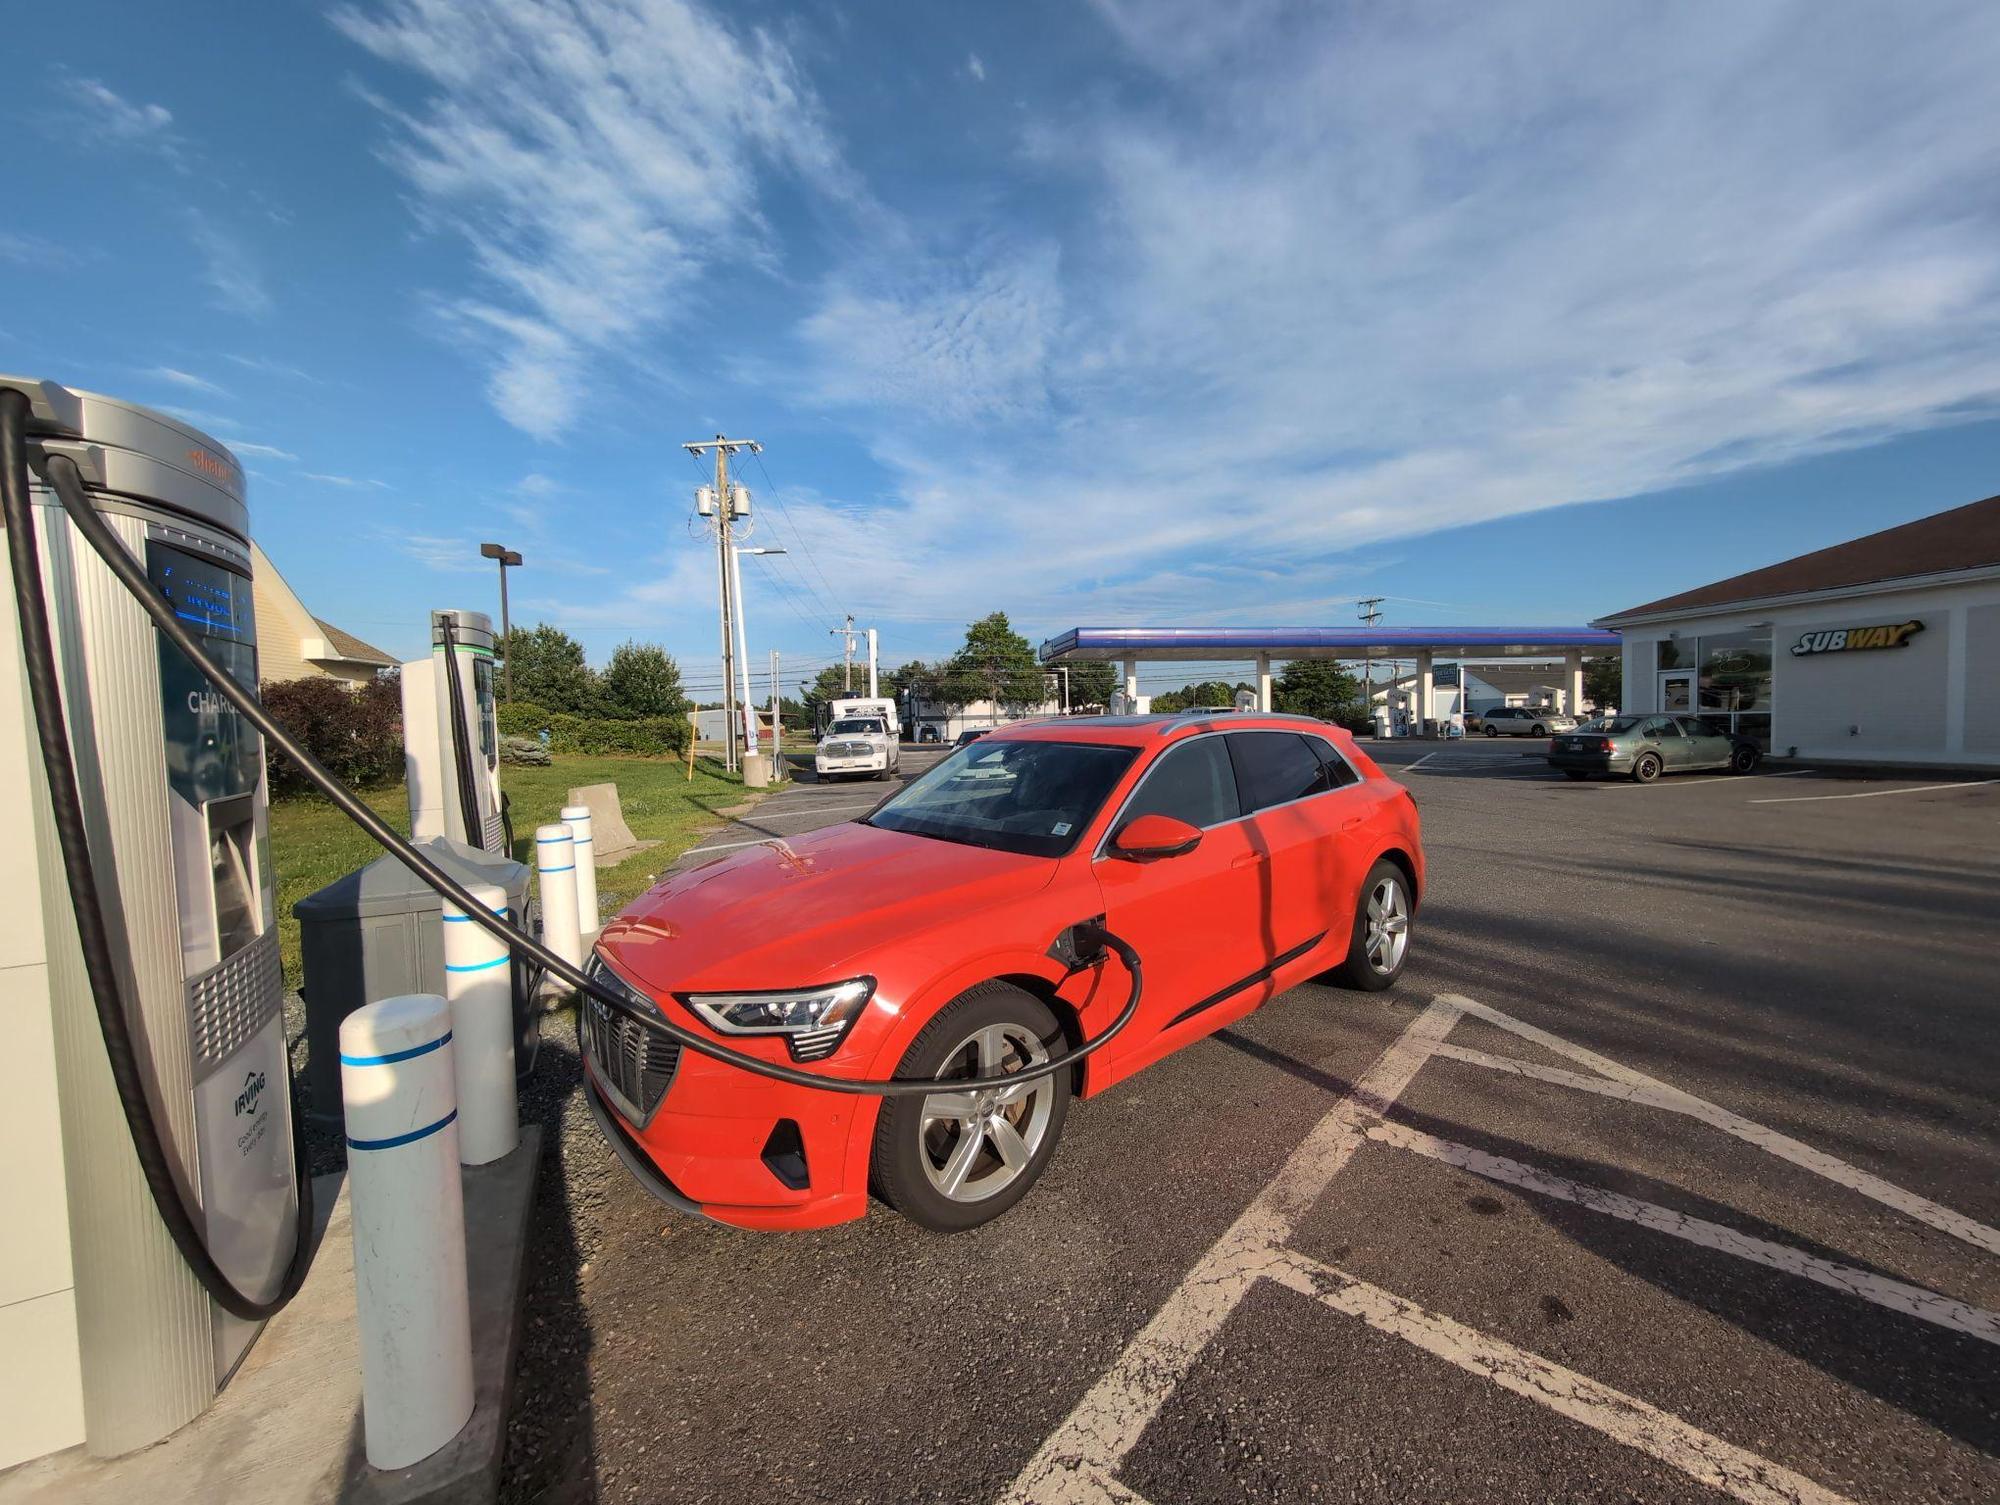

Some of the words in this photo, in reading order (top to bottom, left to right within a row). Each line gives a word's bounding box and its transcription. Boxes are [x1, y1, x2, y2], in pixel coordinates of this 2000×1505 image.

[1791, 620, 1924, 656] SUBWAY
[187, 690, 241, 714] CHARG
[234, 1071, 266, 1117] IRVING
